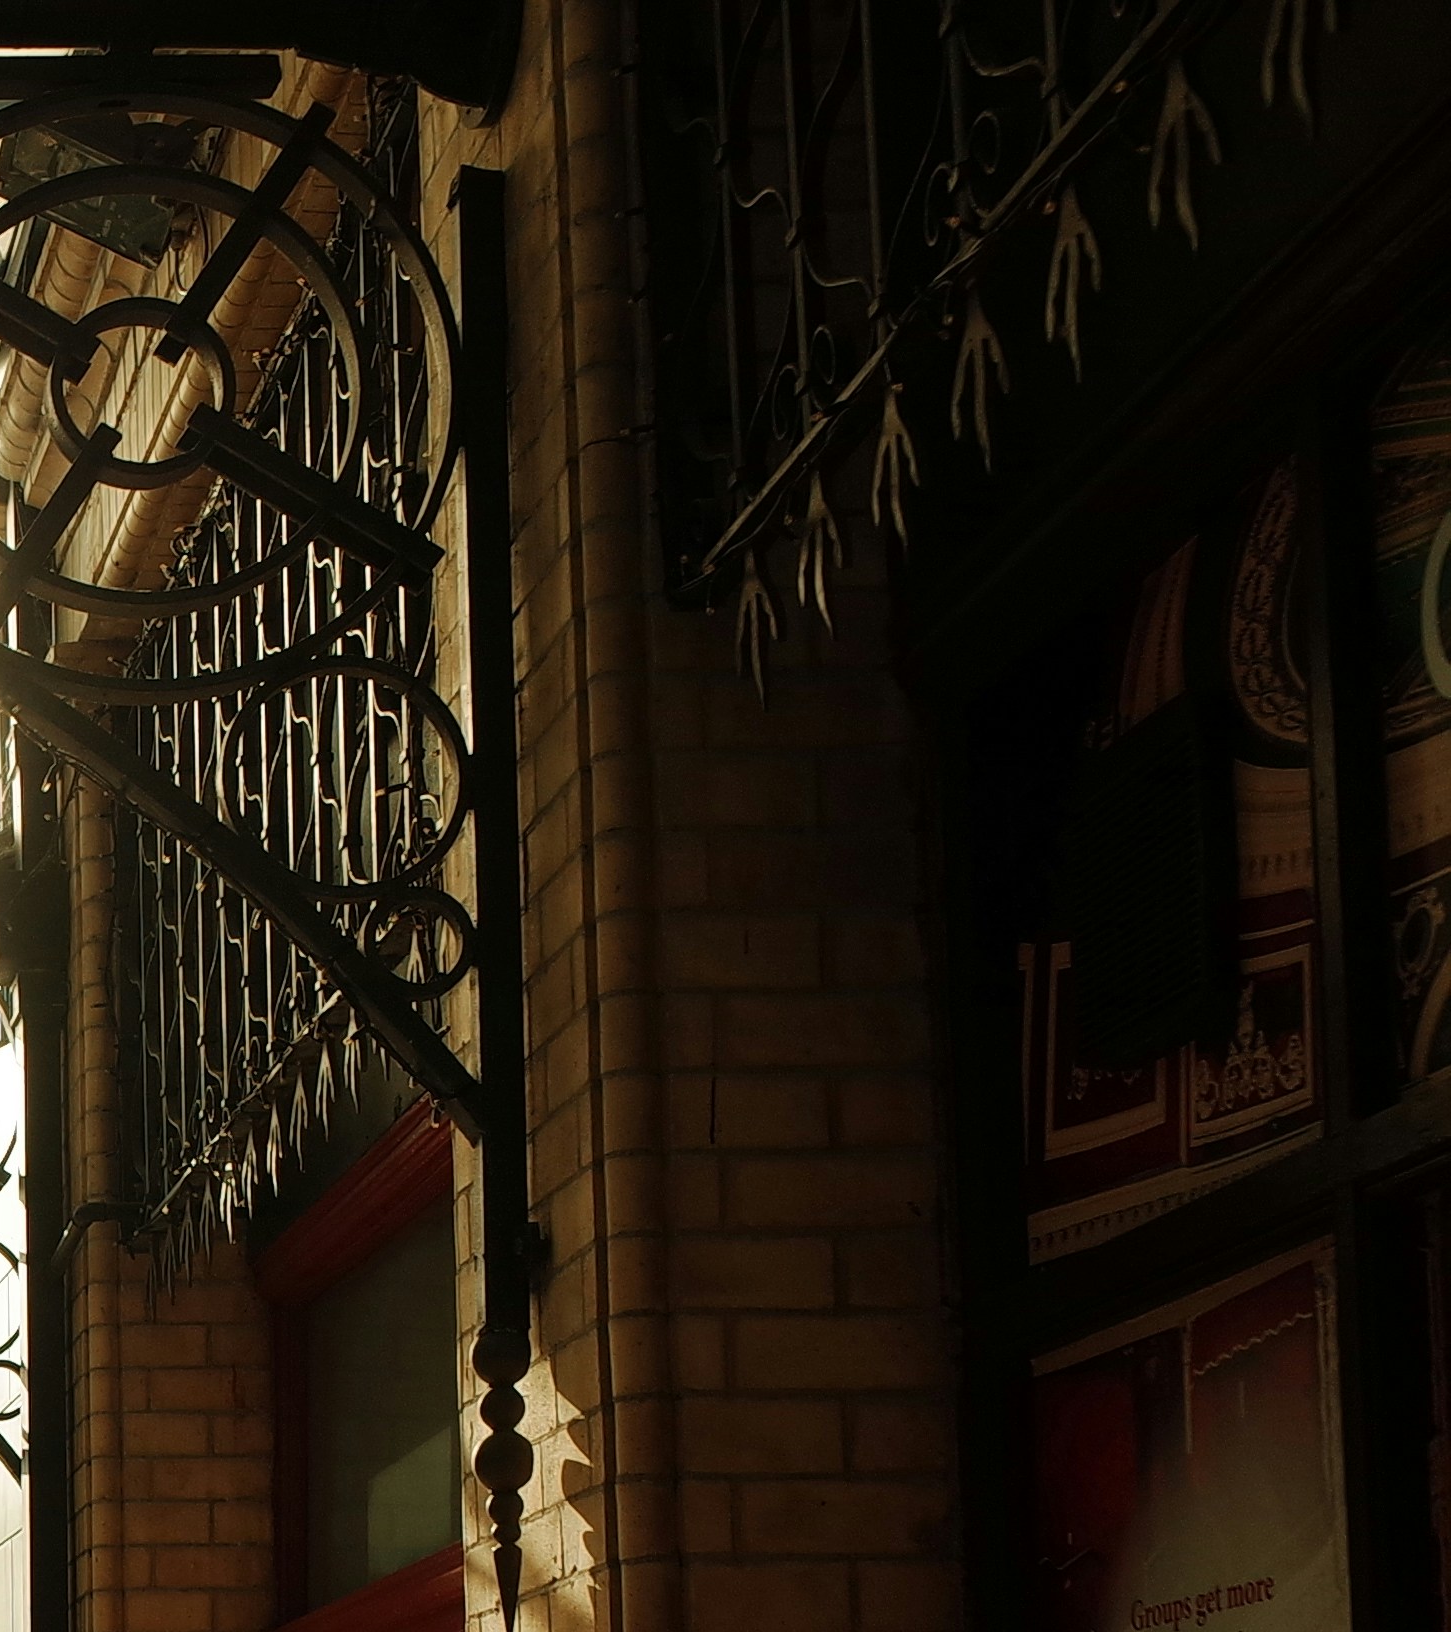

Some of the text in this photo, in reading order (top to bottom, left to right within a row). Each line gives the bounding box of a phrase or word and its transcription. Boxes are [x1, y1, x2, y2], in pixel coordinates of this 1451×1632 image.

[1131, 1577, 1274, 1631] Groups get more
